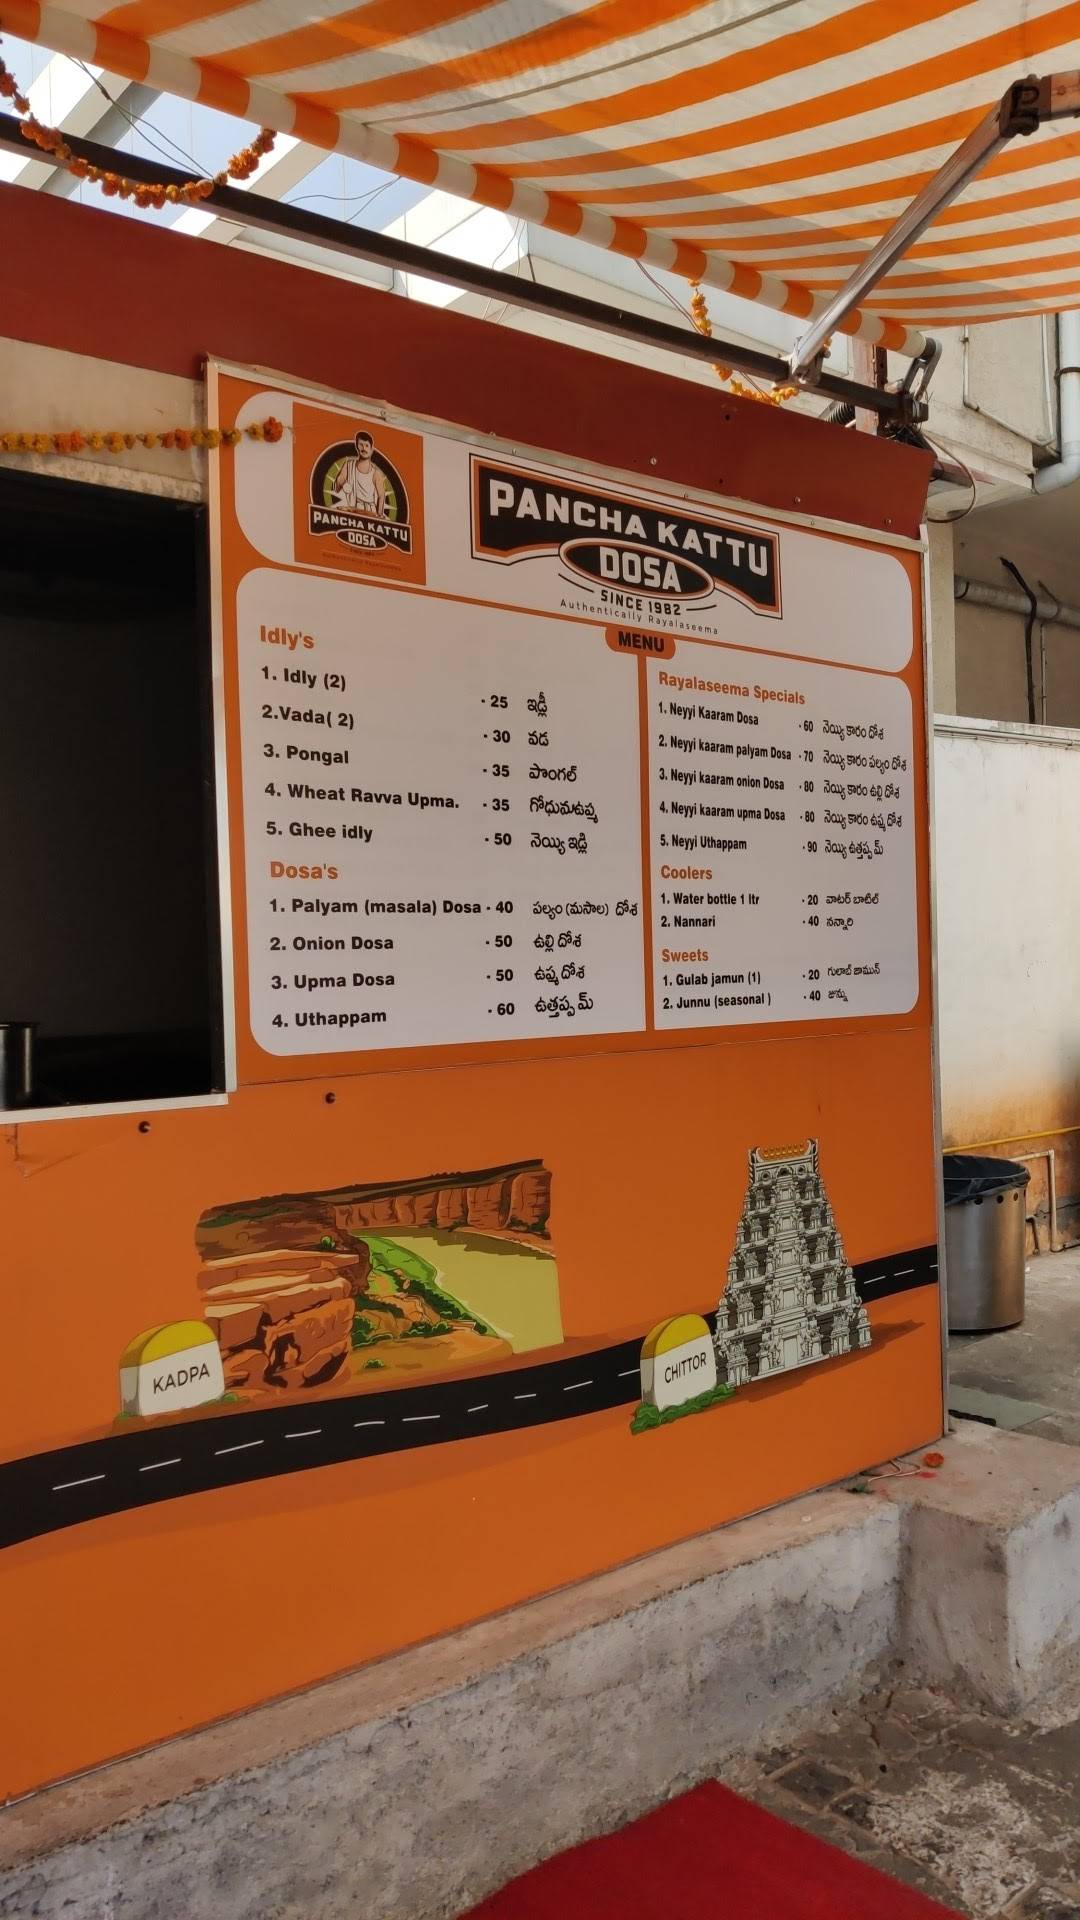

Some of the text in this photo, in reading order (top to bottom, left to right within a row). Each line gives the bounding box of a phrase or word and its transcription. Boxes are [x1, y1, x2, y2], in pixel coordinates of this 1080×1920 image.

[313, 510, 408, 542] PANCHA KATTU
[488, 477, 769, 577] PANCHA KATTU
[347, 531, 377, 548] DOSA
[599, 545, 683, 594] DOSA
[600, 589, 682, 616] SINCE 1982
[559, 597, 719, 636] Authentically Rayalaseema
[259, 625, 315, 651] Idly's
[617, 630, 666, 653] MENU
[261, 665, 347, 693] 1. Idly (2)
[658, 671, 806, 705] Rayalaseema Specials
[490, 694, 509, 709] 25
[658, 701, 759, 726] 1. Neyyi Kaaram Dosa
[803, 720, 814, 732] 60
[492, 729, 511, 744] 30
[528, 730, 549, 747] వడ
[262, 743, 350, 767] 3. Pongal
[658, 734, 792, 761] 2. Neyyi kaaram palyam Dosa
[803, 750, 814, 763] 70
[492, 763, 510, 778] 35
[659, 767, 785, 790] 3. Neyyi kaaram onion Dosa
[804, 780, 814, 793] 80
[264, 782, 460, 810] 4. Wheat Ravva Upma.
[491, 798, 510, 812] 35
[659, 800, 786, 821] 4. Neyyi kaaram upma Dosa
[804, 810, 815, 823] 80
[265, 821, 374, 844] 5. Ghee idly
[494, 832, 513, 846] 50
[660, 834, 748, 852] 5. Neyyi Uthappam
[807, 841, 818, 853] 90
[269, 861, 339, 880] Dosa's
[660, 864, 713, 881] Coolers
[660, 892, 760, 905] 1. Water bottle 1 ltr
[807, 894, 819, 906] 20
[269, 898, 482, 917] 1. Palyam (masala) Dosa
[495, 900, 514, 915] 40
[660, 915, 716, 928] 2. Nannari
[807, 915, 820, 927] 40
[269, 936, 395, 951] 2. Onion Dosa
[494, 934, 513, 948] 50
[661, 948, 709, 963] Sweets
[271, 972, 396, 992] 3. Upma Dosa
[495, 968, 514, 982] 50
[663, 971, 761, 988] 1. Gulab jamun (1)
[808, 969, 820, 981] 20
[663, 997, 673, 1010] 2.
[676, 996, 711, 1009] Junnu
[809, 990, 821, 1001] 40
[497, 1002, 515, 1016] 60
[271, 1011, 387, 1028] 4. Uthappam
[664, 1351, 707, 1384] CHITTOR
[152, 1362, 211, 1395] KADPA
